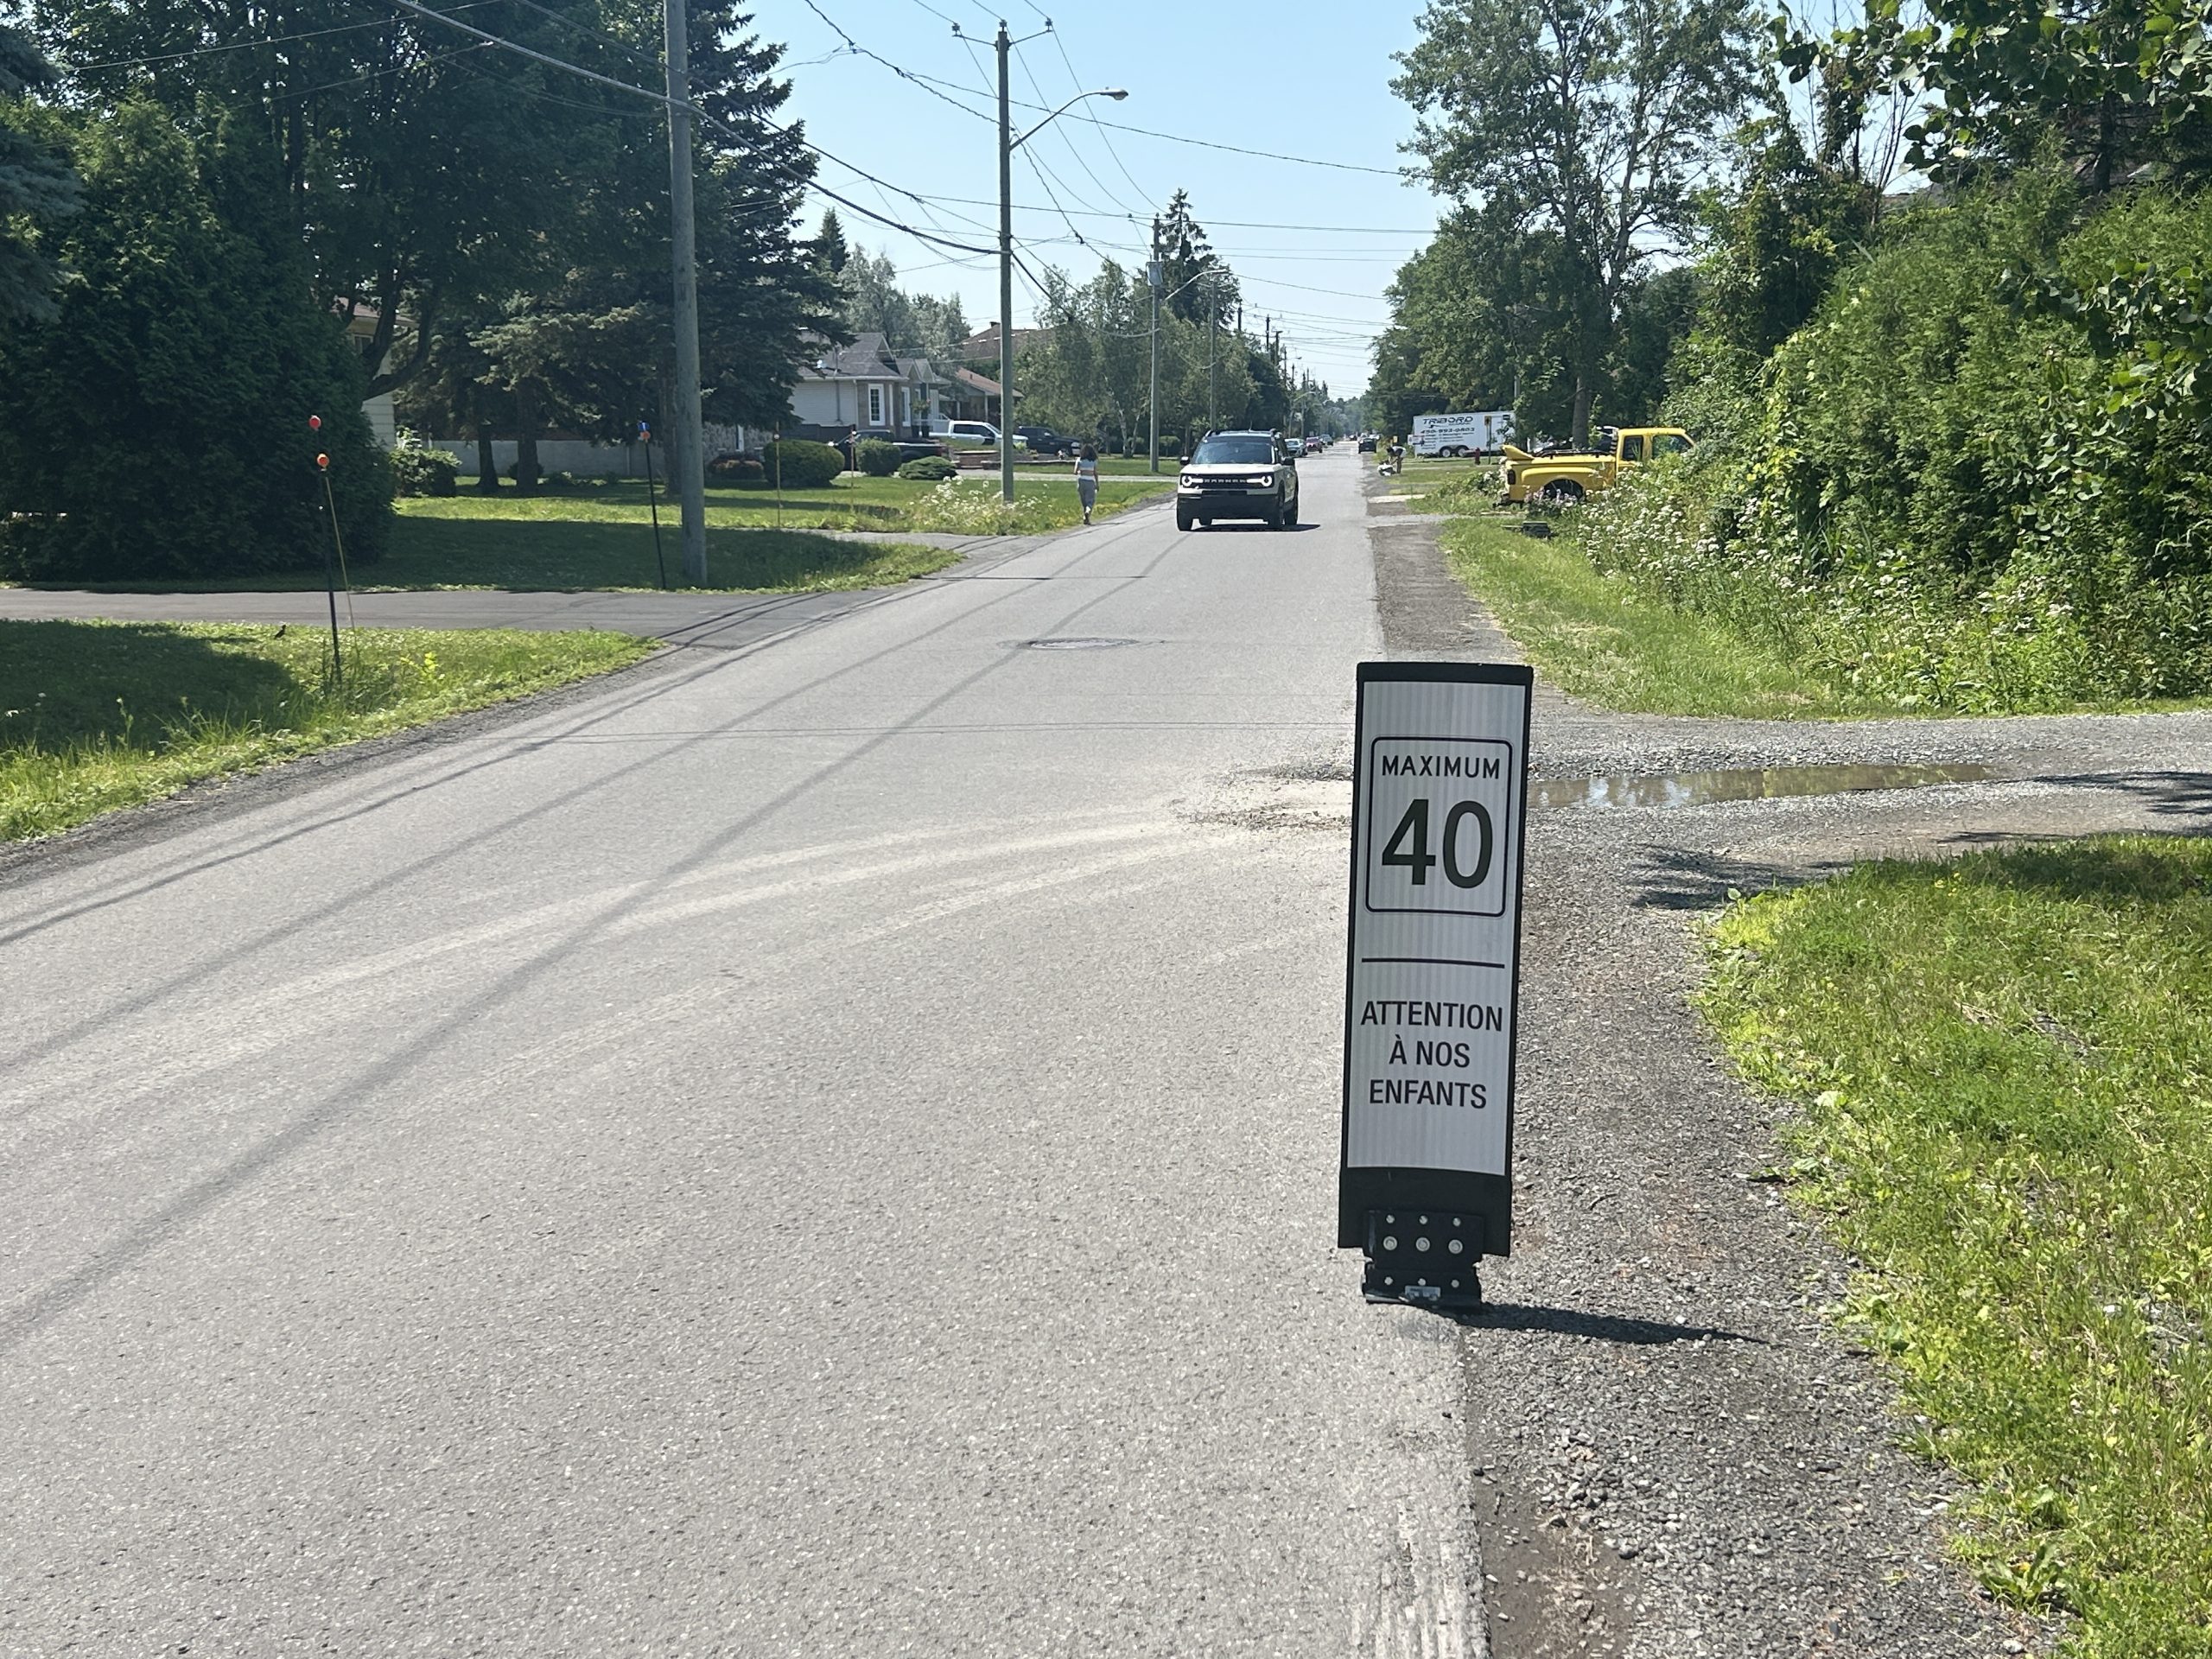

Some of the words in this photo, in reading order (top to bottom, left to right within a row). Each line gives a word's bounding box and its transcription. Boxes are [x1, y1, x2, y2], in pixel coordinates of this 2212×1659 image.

[1382, 755, 1500, 779] MAXIMUM
[1382, 798, 1493, 889] 40
[1360, 1001, 1503, 1032] ATTENTION
[1389, 1034, 1407, 1065] À
[1415, 1040, 1470, 1068] NOS
[1370, 1079, 1487, 1109] ENFANTS
